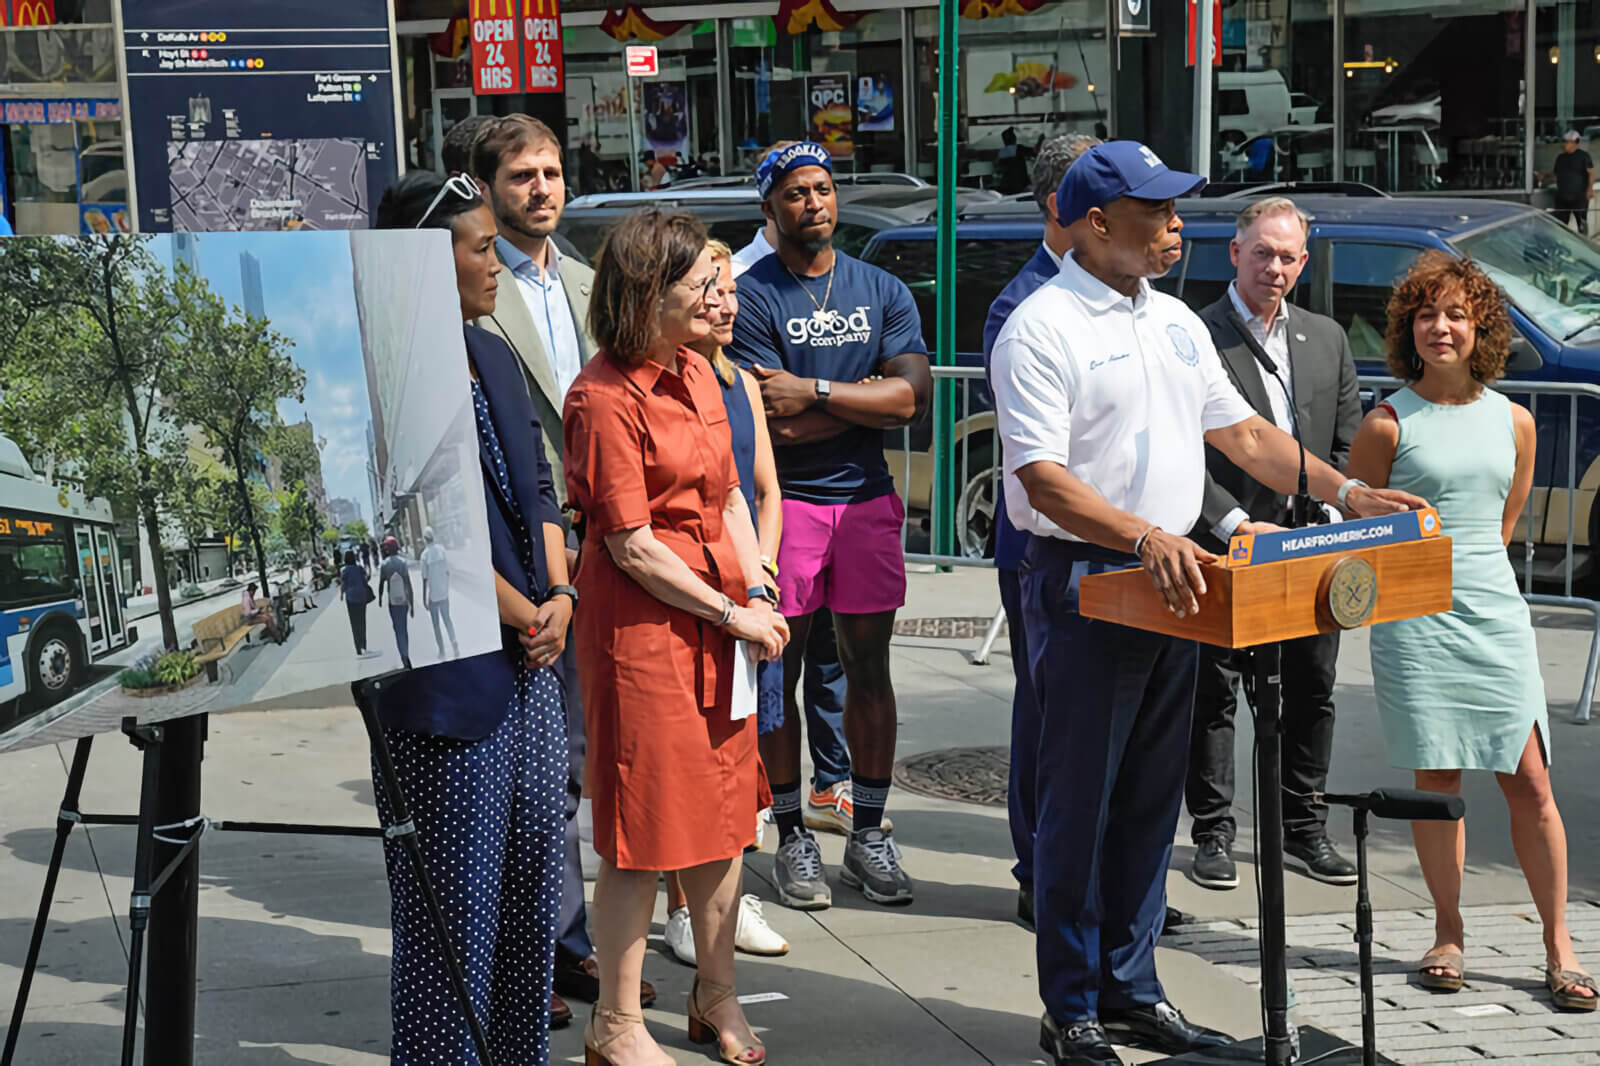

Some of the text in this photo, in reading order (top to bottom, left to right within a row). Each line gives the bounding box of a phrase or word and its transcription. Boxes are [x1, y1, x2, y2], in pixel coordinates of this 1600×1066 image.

[474, 19, 514, 42] OPEN
[524, 18, 558, 41] OPEN
[485, 43, 505, 66] 24
[535, 41, 551, 64] 24
[481, 66, 513, 88] HRS
[531, 65, 558, 87] HRS
[811, 89, 845, 110] QPC
[786, 306, 872, 345] good
[810, 332, 871, 348] company
[1282, 524, 1394, 552] HEARFROMERIC.COM
